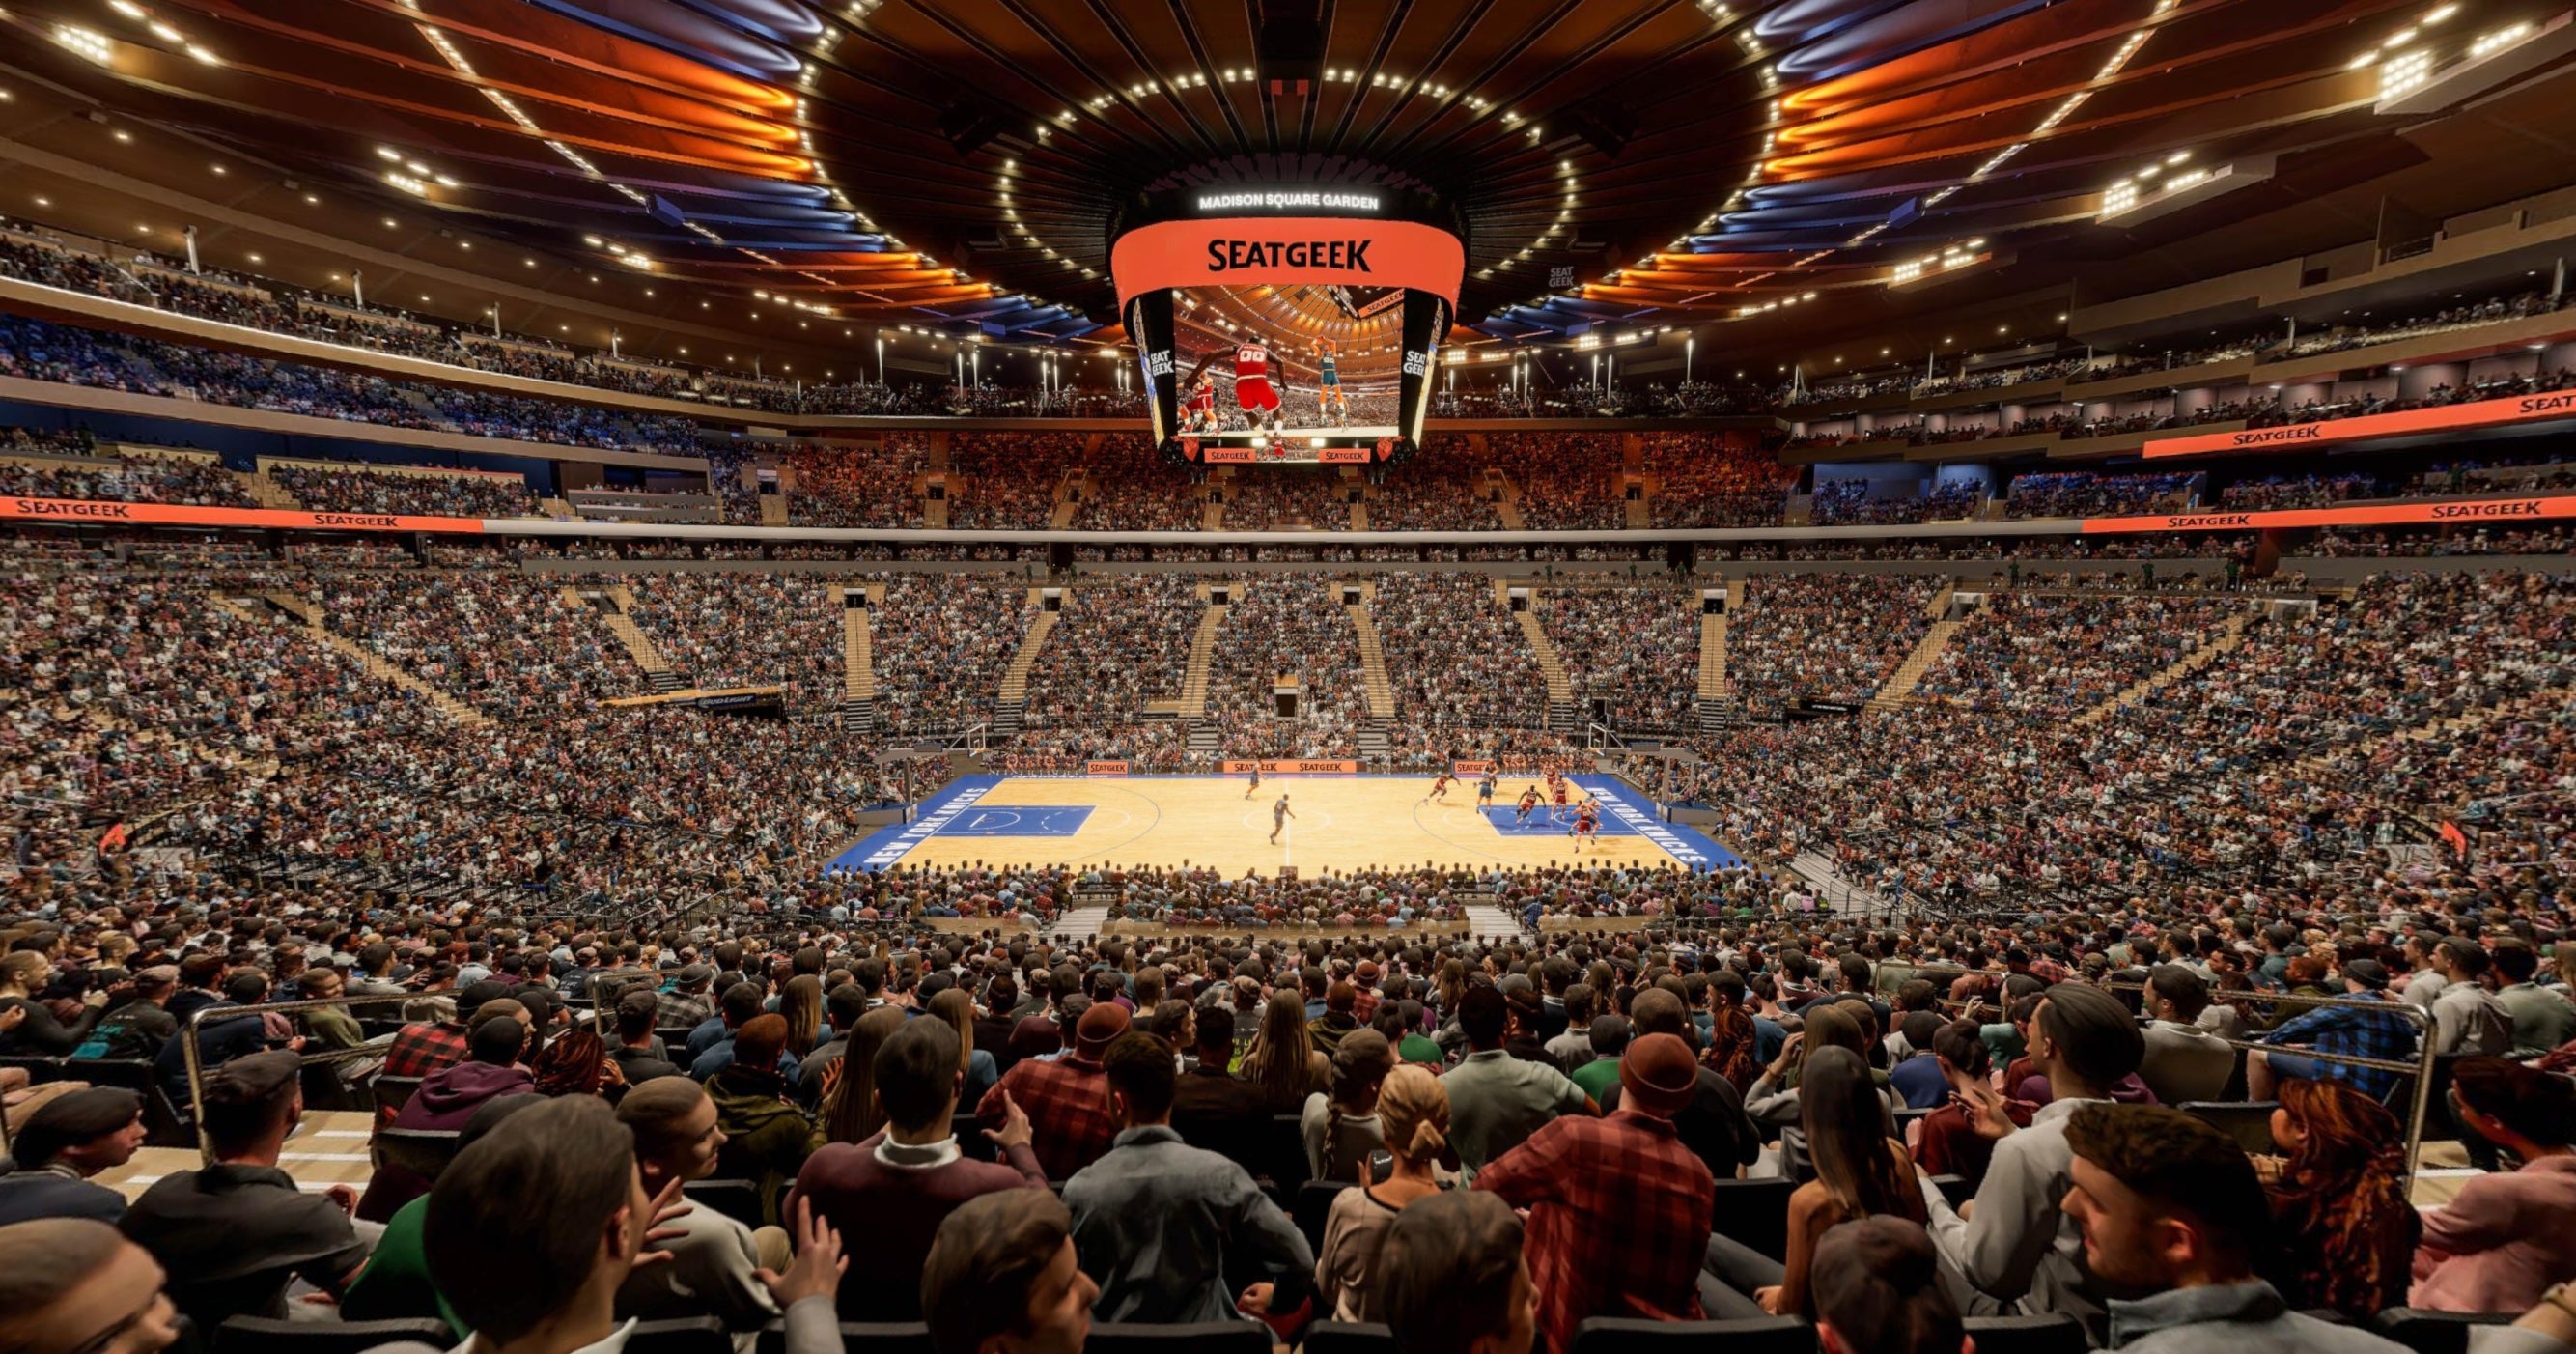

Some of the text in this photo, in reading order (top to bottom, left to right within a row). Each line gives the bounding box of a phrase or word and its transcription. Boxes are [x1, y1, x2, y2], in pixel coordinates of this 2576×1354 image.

[1199, 193, 1379, 209] MADISON SQUARE GARDEN
[1208, 239, 1372, 272] SEATGEEK
[1550, 266, 1574, 277] SEAT
[1549, 276, 1574, 288] GEEK
[2233, 425, 2320, 445] SEATGEEK
[1211, 451, 1249, 460] SEATGEEK
[1325, 451, 1363, 460] SEATGEEK
[17, 500, 130, 518] SEATGEEK
[2432, 501, 2542, 518] SEATGEEK
[314, 514, 398, 527] SEATGEEK
[2168, 515, 2250, 528] SEATGEEK
[1235, 763, 1277, 772] SEATEEK
[1299, 763, 1342, 772] SEATGEEK
[864, 787, 988, 863] NEW YORK KNICKS
[1636, 826, 1709, 862] KNICKS
